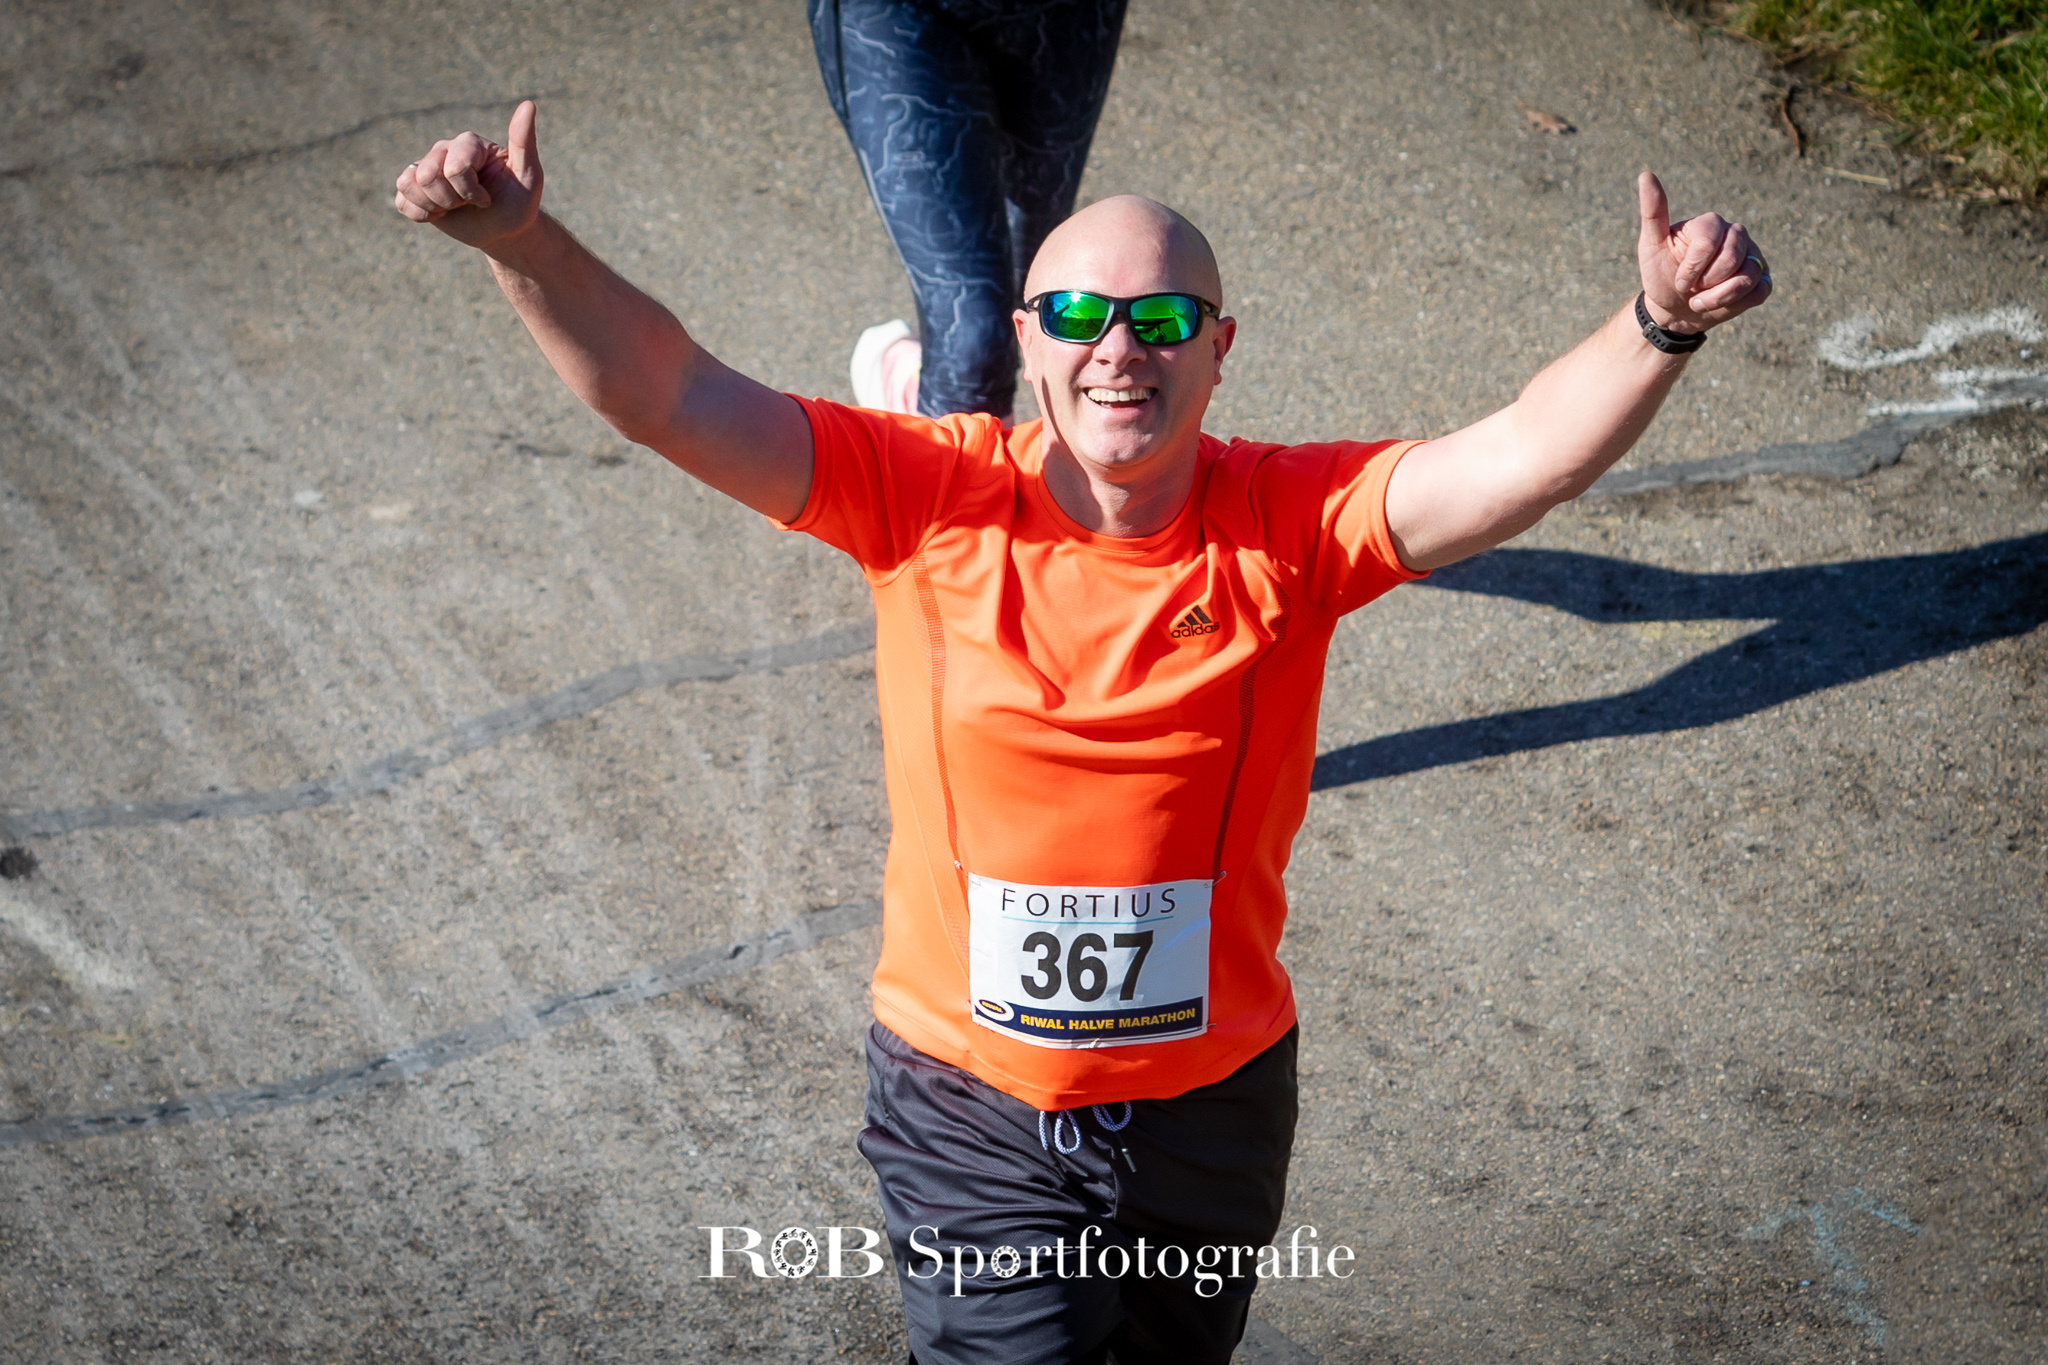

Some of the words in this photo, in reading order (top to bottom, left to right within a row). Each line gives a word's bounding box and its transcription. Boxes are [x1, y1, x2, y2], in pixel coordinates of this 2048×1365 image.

[1171, 622, 1220, 638] adidas
[1001, 888, 1176, 918] FORTIUS
[1020, 930, 1154, 1002] 367
[1020, 1014, 1064, 1030] RIWAL
[1068, 1018, 1114, 1030] HALVE
[1118, 1007, 1196, 1028] MARATHON
